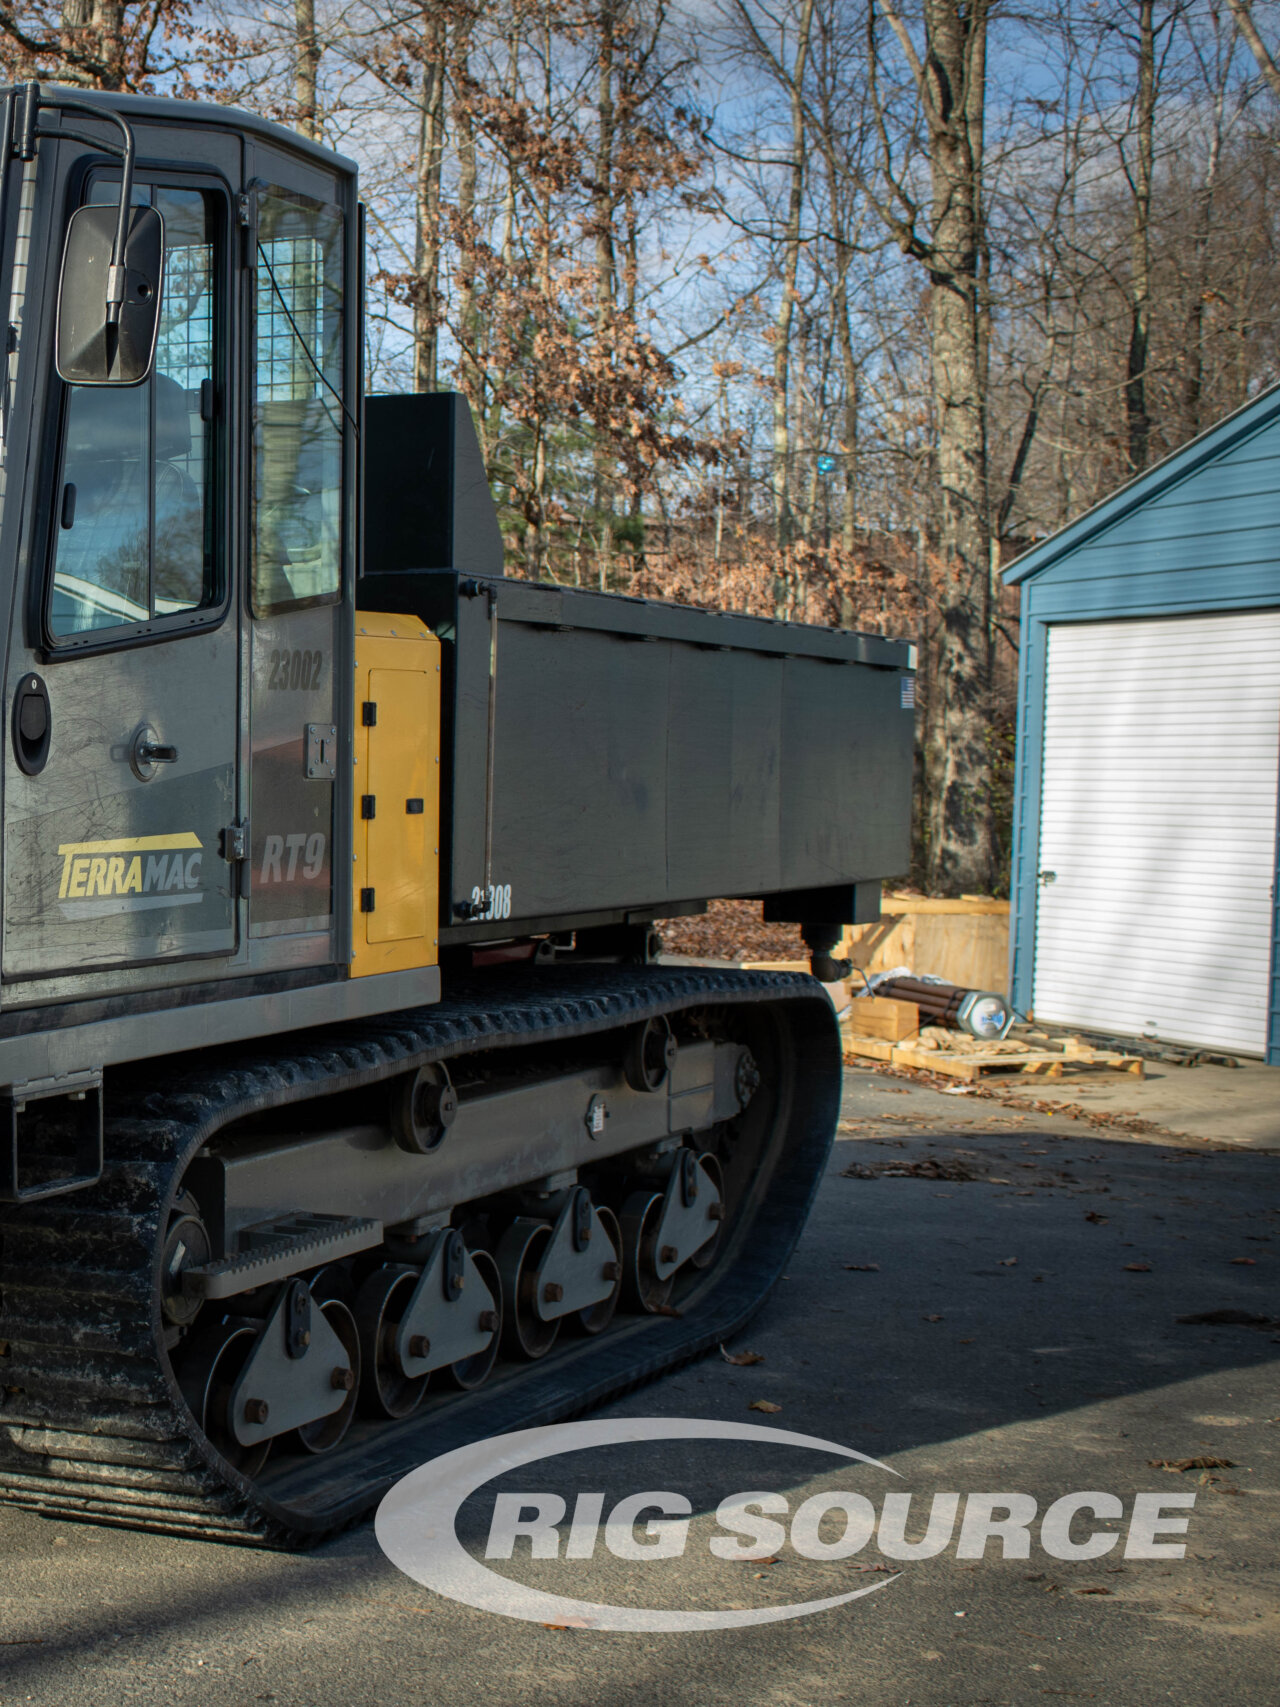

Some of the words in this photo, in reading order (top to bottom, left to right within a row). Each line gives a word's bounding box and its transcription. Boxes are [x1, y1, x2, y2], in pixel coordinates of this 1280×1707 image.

[268, 649, 322, 690] 23002
[58, 832, 203, 899] TERRAMAC
[260, 832, 326, 883] RT9
